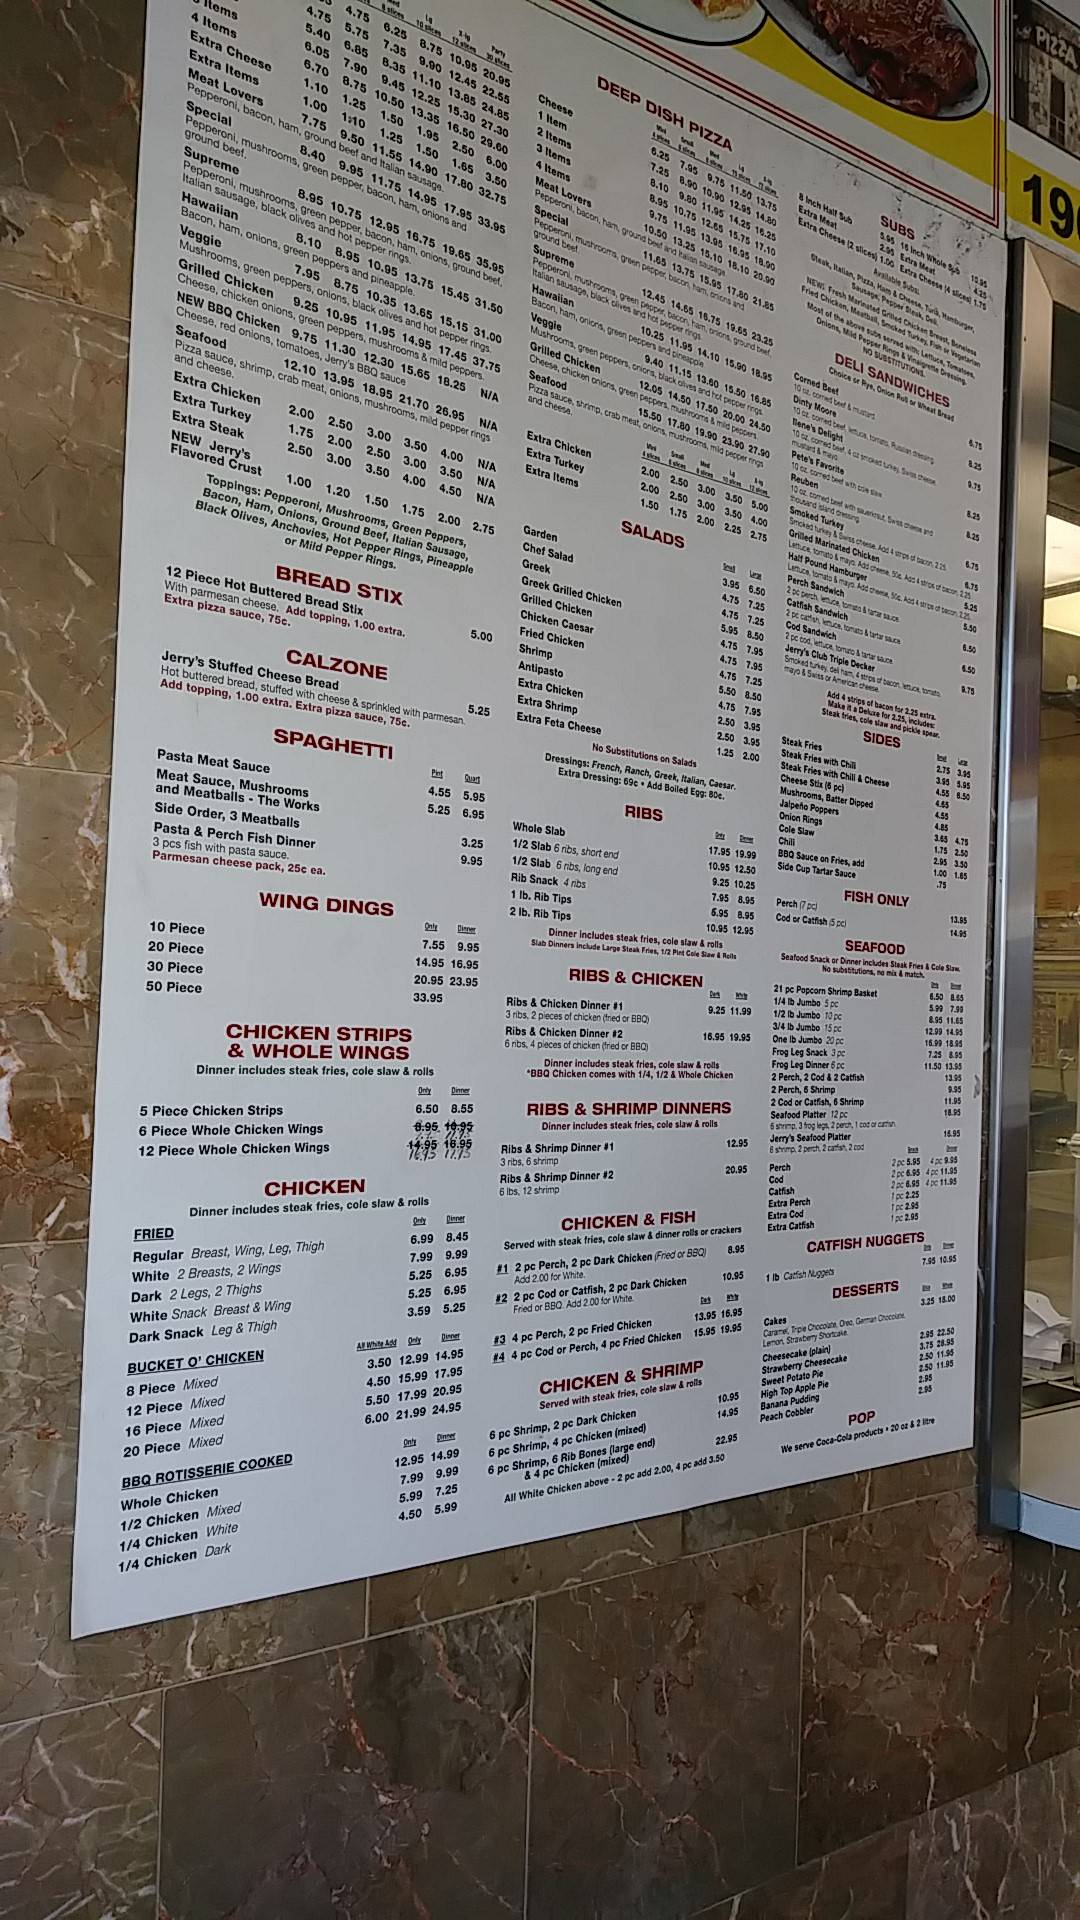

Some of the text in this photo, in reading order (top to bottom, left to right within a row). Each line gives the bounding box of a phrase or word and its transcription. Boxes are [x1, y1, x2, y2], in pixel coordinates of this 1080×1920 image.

[190, 29, 271, 72] Extra Cheese
[1035, 26, 1079, 70] PIZZA
[188, 67, 263, 107] Meat Lovers
[186, 100, 232, 127] Special
[597, 75, 732, 152] DEEP DISH PIZZA
[184, 145, 239, 175] Supreme
[302, 113, 507, 205] 7.75 9.50 11.55 14.90 17.80 32.75
[182, 191, 238, 220] Hawaiian
[1023, 174, 1080, 239] 19
[180, 223, 221, 248] Veggie
[880, 215, 915, 240] SUBS
[176, 290, 280, 333] NEW BBQ Chicken
[175, 324, 227, 349] Seafood
[834, 352, 950, 408] DELI SANDWICHES
[173, 390, 252, 423] Extra Turkey
[170, 442, 262, 476] Flavored Crust
[790, 472, 818, 489] Reuben
[789, 505, 844, 531] Smoked Turkey
[523, 525, 557, 542] Garden
[621, 520, 684, 549] SALADS
[522, 541, 573, 563] Chef Salad
[522, 558, 550, 574] Greek
[164, 579, 187, 593] With
[190, 587, 239, 604] parmesan
[167, 565, 363, 615] 12 Piece Hot Buttered Bread Stix
[276, 565, 403, 606] BREAD STIX
[721, 593, 765, 611] 4.75 7.25
[470, 629, 492, 642] 5.00
[518, 643, 552, 660] Shrimp
[208, 658, 253, 676] Stuffed
[257, 667, 301, 684] Cheese
[305, 675, 339, 691] Bread
[286, 649, 388, 681] CALZONE
[518, 660, 563, 678] Antipasto
[467, 704, 490, 717] 5.25
[516, 711, 601, 735] Extra Feta Cheese
[274, 728, 393, 760] SPAGHETTI
[781, 735, 822, 752] Steak Fries
[862, 730, 901, 748] SIDES
[157, 748, 271, 773] Pasta Meat Sauce
[592, 742, 604, 752] No
[605, 745, 658, 762] Substitutions
[671, 756, 696, 768] Salads
[428, 786, 485, 802] 4.55 5.95
[624, 804, 663, 822] RIBS
[779, 811, 822, 826] Onion Rings
[512, 821, 566, 837] Whole Slab
[152, 849, 209, 864] Parmesan
[212, 856, 252, 868] cheese
[708, 846, 756, 860] 17.95 19.99
[259, 891, 394, 917] WING DINGS
[844, 889, 909, 907] FISH ONLY
[150, 921, 205, 935] 10 Piece
[422, 939, 479, 952] 7.55 9.95
[845, 939, 905, 955] SEAFOOD
[569, 967, 703, 988] RIBS & CHICKEN
[226, 1023, 412, 1043] CHICKEN STRIPS
[228, 1043, 409, 1060] & WHOLE WINGS
[140, 1104, 283, 1117] 5 Piece Chicken Strips
[415, 1103, 473, 1114] 6.50 8.55
[526, 1101, 731, 1116] RIBS & SHRIMP DINNERS
[264, 1178, 365, 1197] CHICKEN
[561, 1210, 696, 1231] CHICKEN & FISH
[134, 1227, 174, 1240] FRIED
[410, 1231, 468, 1244] 6.99 8.45
[806, 1236, 862, 1253] CATFISH
[865, 1231, 925, 1248] NUGGETS
[133, 1249, 184, 1263] Regular
[296, 1240, 324, 1254] Thigh
[832, 1280, 899, 1299] DESSERTS
[763, 1316, 787, 1326] Cakes
[127, 1357, 184, 1375] BUCKET
[205, 1349, 264, 1365] CHICKEN
[762, 1344, 831, 1363] Cheesecake (plain)
[126, 1375, 219, 1397] 8 Piece Mixed
[539, 1360, 704, 1395] CHICKEN & SHRIMP
[760, 1394, 820, 1410] Banana Pudding
[848, 1410, 876, 1426] POP
[122, 1453, 292, 1489] BBQ ROTISSERIE COOKED
[121, 1488, 218, 1511] Whole Chicken
